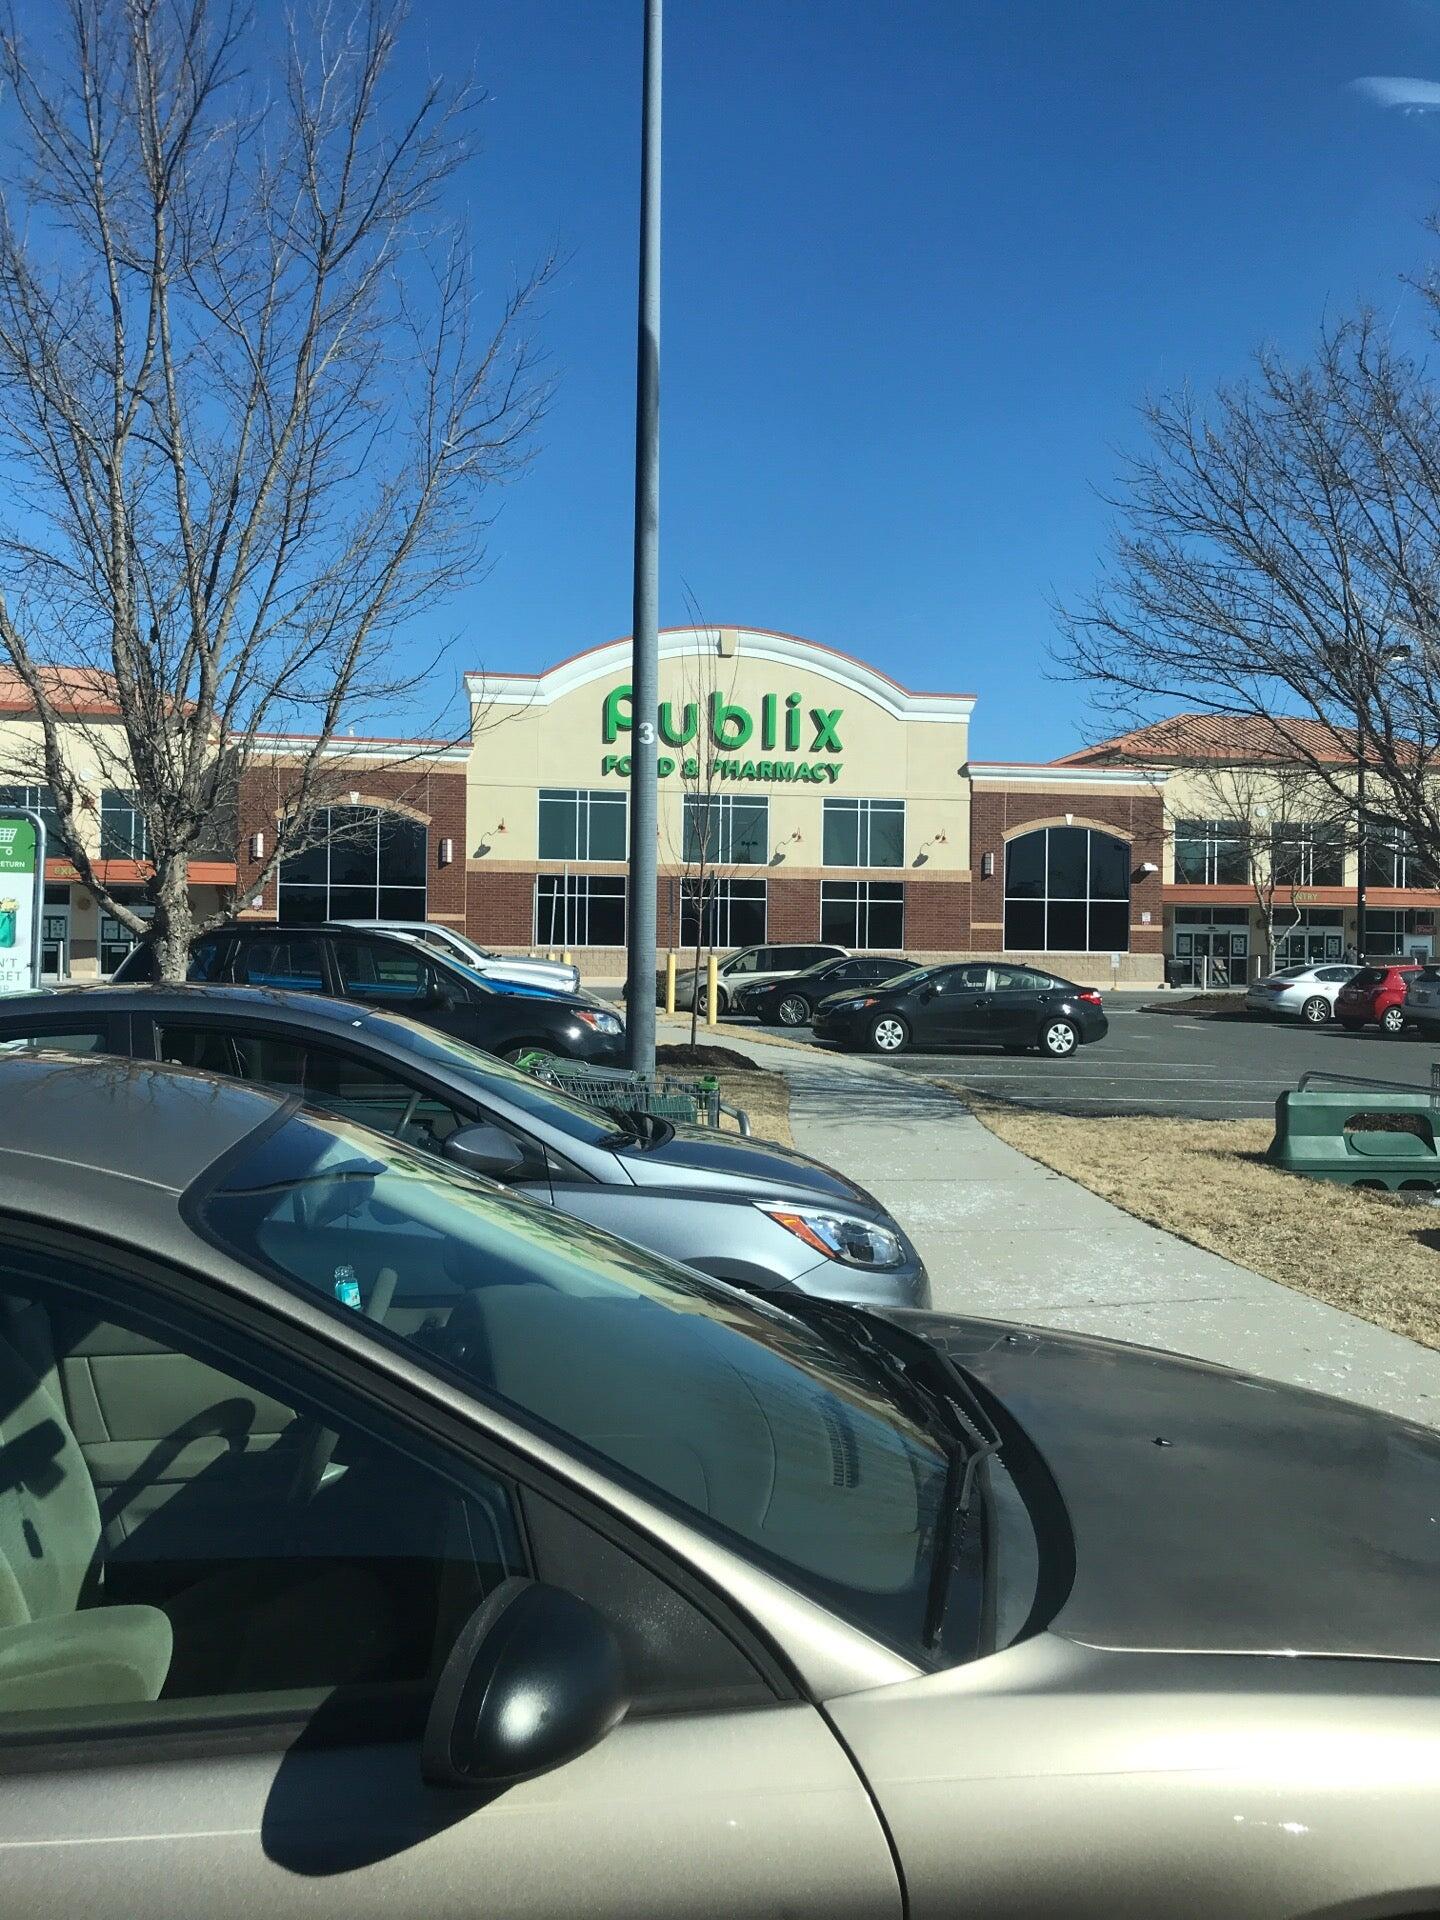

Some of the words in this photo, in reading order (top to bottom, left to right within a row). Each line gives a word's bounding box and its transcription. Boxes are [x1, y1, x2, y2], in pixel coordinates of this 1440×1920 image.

[602, 684, 843, 752] Publix
[639, 722, 654, 745] 3
[602, 755, 675, 778] FOD
[681, 757, 698, 779] &
[706, 758, 843, 784] PHARMACY
[0, 860, 26, 868] ETURN
